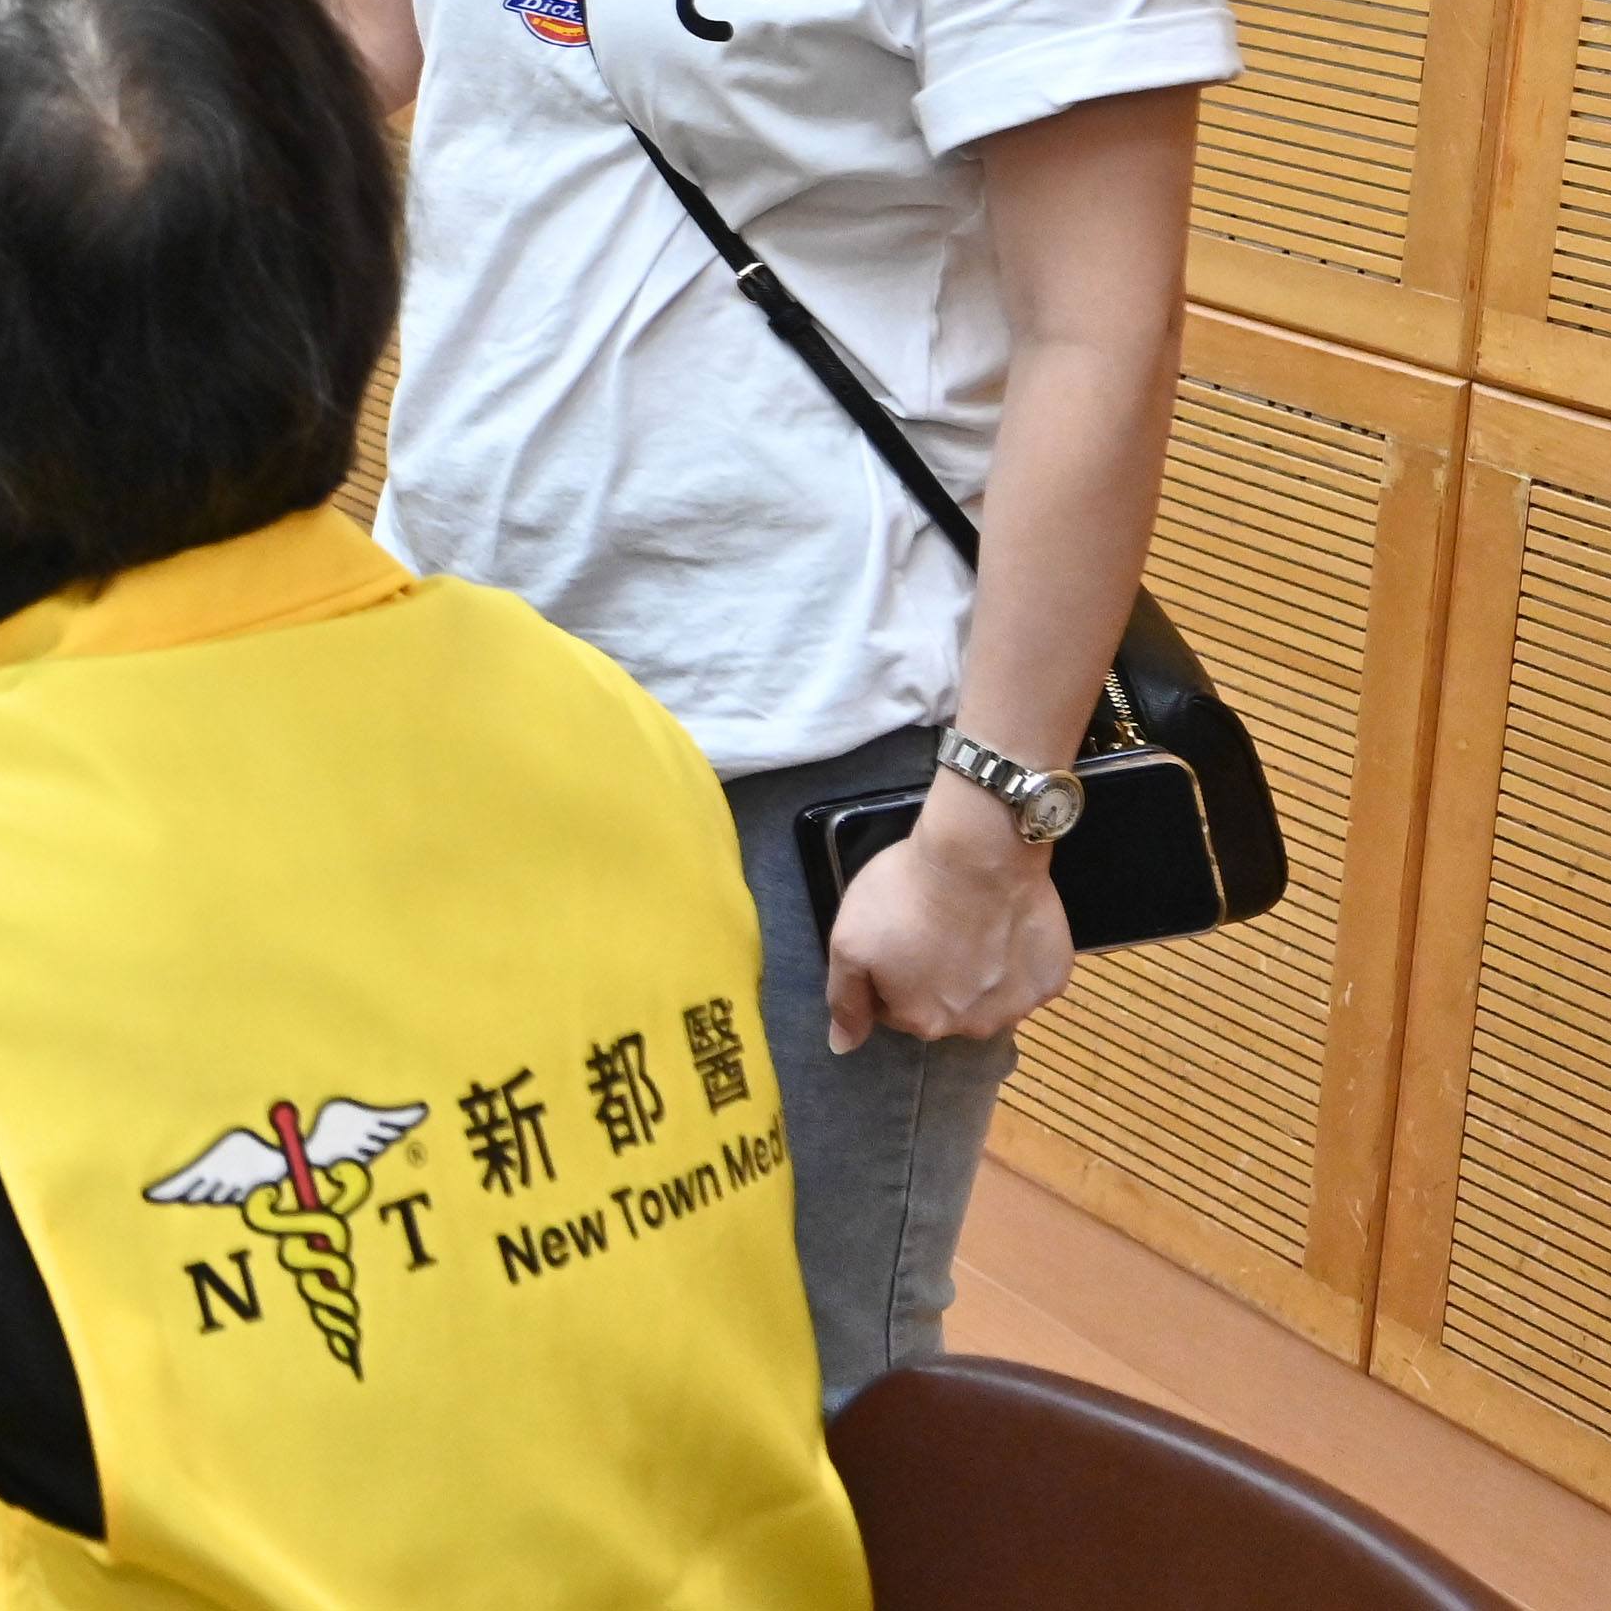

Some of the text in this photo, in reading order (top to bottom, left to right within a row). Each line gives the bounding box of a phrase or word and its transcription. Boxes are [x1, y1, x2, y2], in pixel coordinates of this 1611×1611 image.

[182, 1191, 439, 1334] N T
[496, 1209, 609, 1286] New
[610, 1162, 725, 1240] Town
